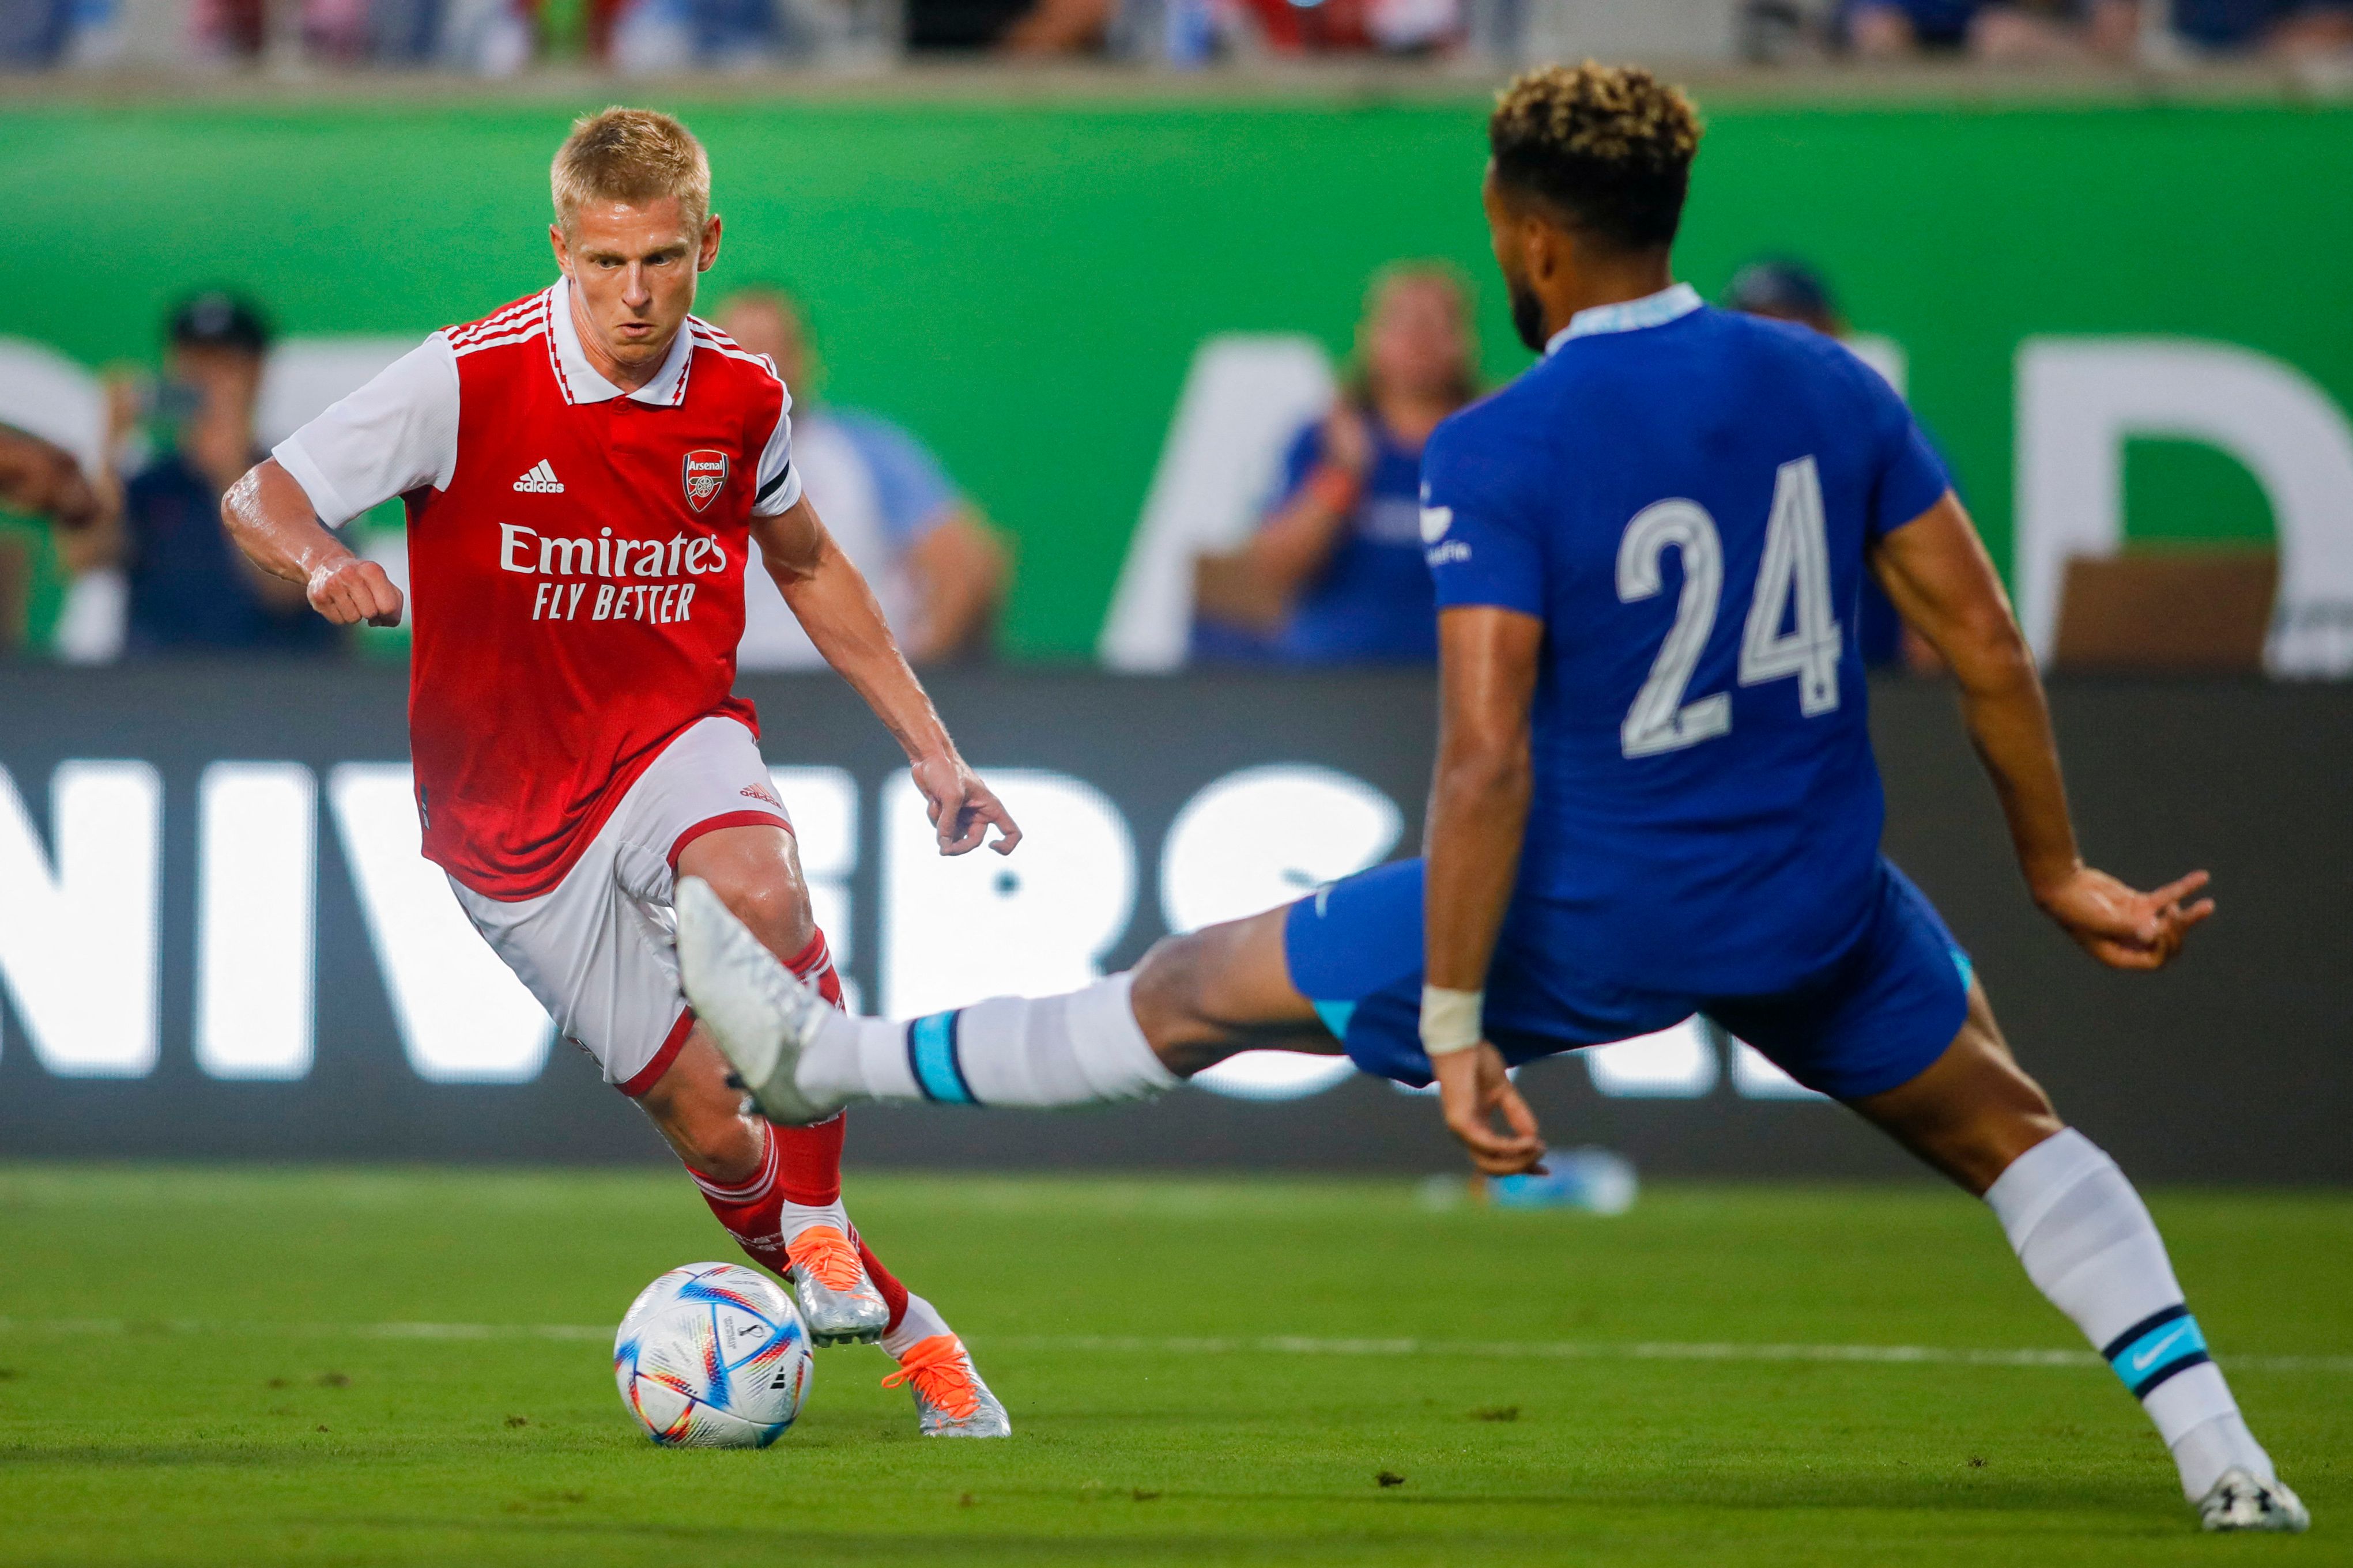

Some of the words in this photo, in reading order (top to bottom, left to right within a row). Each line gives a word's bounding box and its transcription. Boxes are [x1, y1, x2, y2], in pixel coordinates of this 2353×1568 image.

[512, 480, 564, 493] adidas
[689, 460, 722, 471] Arsenal
[499, 522, 727, 577] Emirates
[532, 583, 586, 621] FLY
[591, 583, 696, 625] BETTER
[1616, 455, 1841, 758] 24
